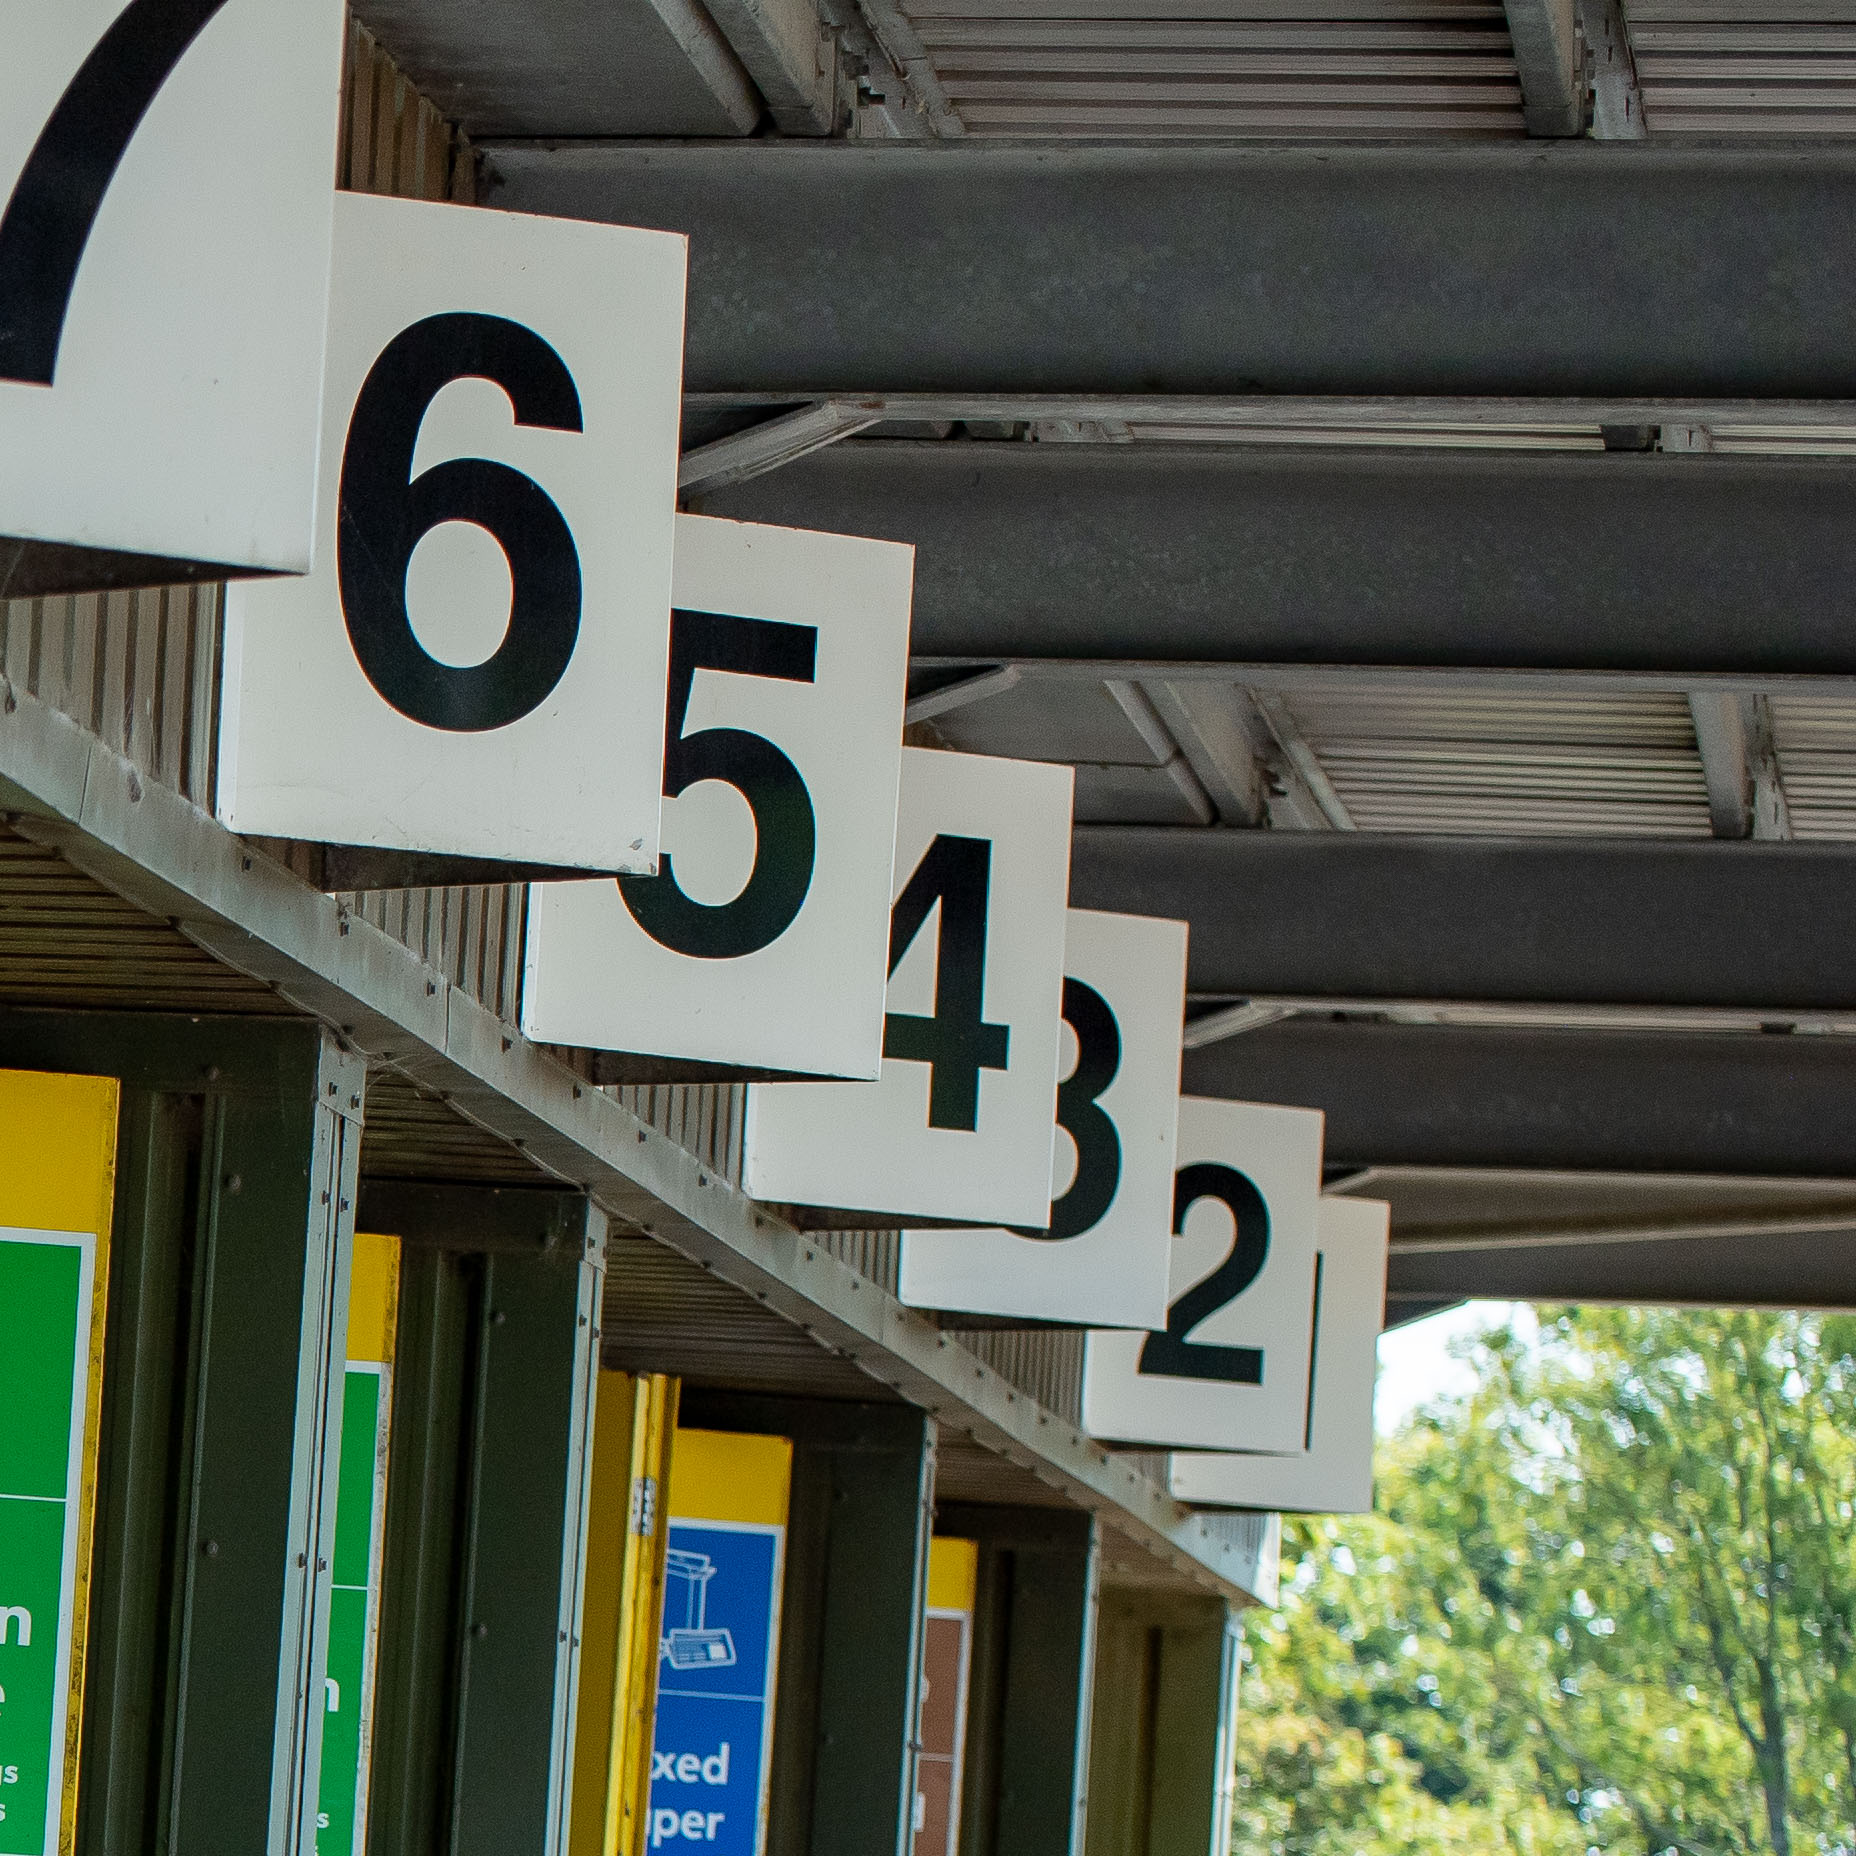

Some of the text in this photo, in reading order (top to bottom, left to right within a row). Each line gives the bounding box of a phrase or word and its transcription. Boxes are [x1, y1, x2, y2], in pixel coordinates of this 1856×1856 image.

[335, 311, 585, 734] 6
[615, 609, 819, 961] 5
[880, 833, 1011, 1133] 4
[1003, 975, 1123, 1244] 3
[1136, 1160, 1273, 1387] 2
[647, 1807, 726, 1849] per
[649, 1741, 731, 1786] xed
